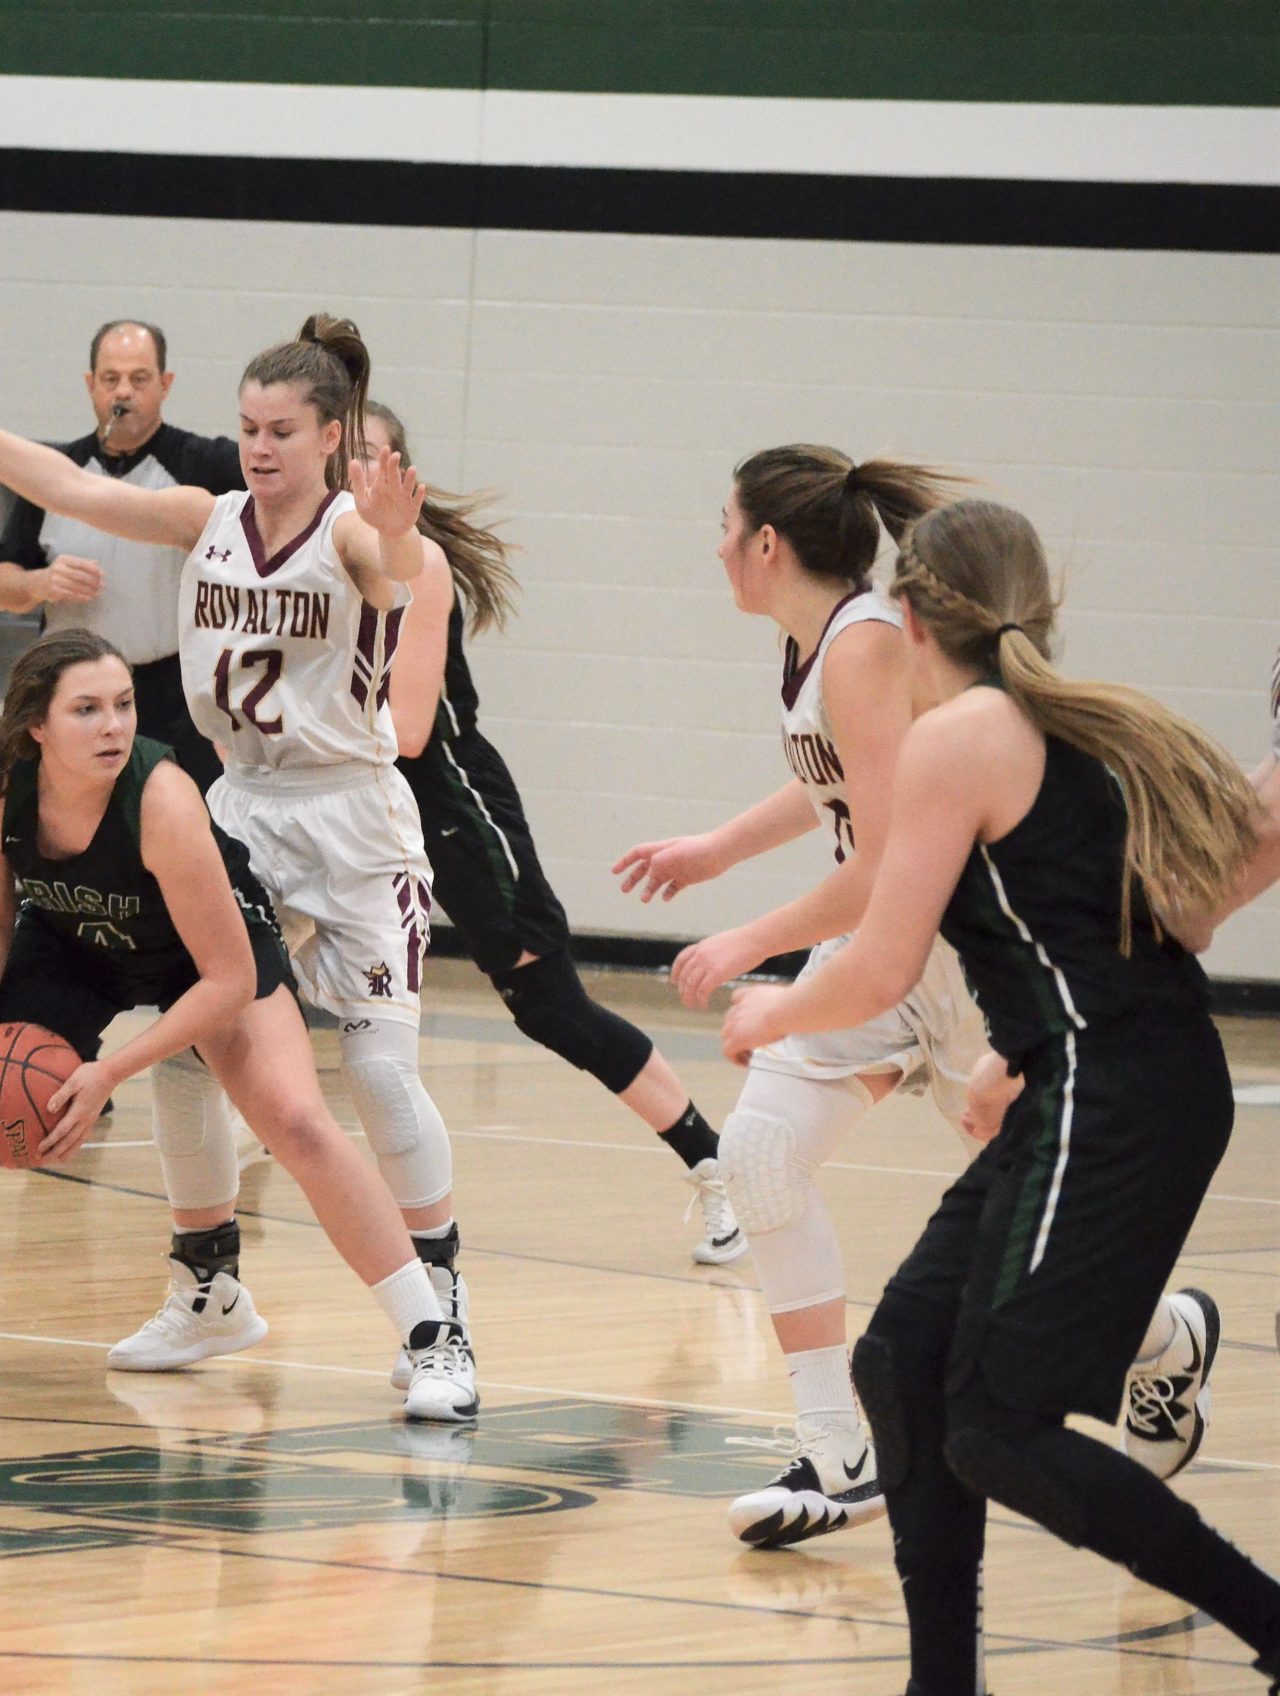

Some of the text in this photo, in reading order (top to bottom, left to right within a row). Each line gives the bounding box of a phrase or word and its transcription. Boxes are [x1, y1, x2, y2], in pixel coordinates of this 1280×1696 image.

[194, 579, 331, 641] ROYALTON
[214, 648, 284, 734] 12
[17, 877, 140, 920] RISH
